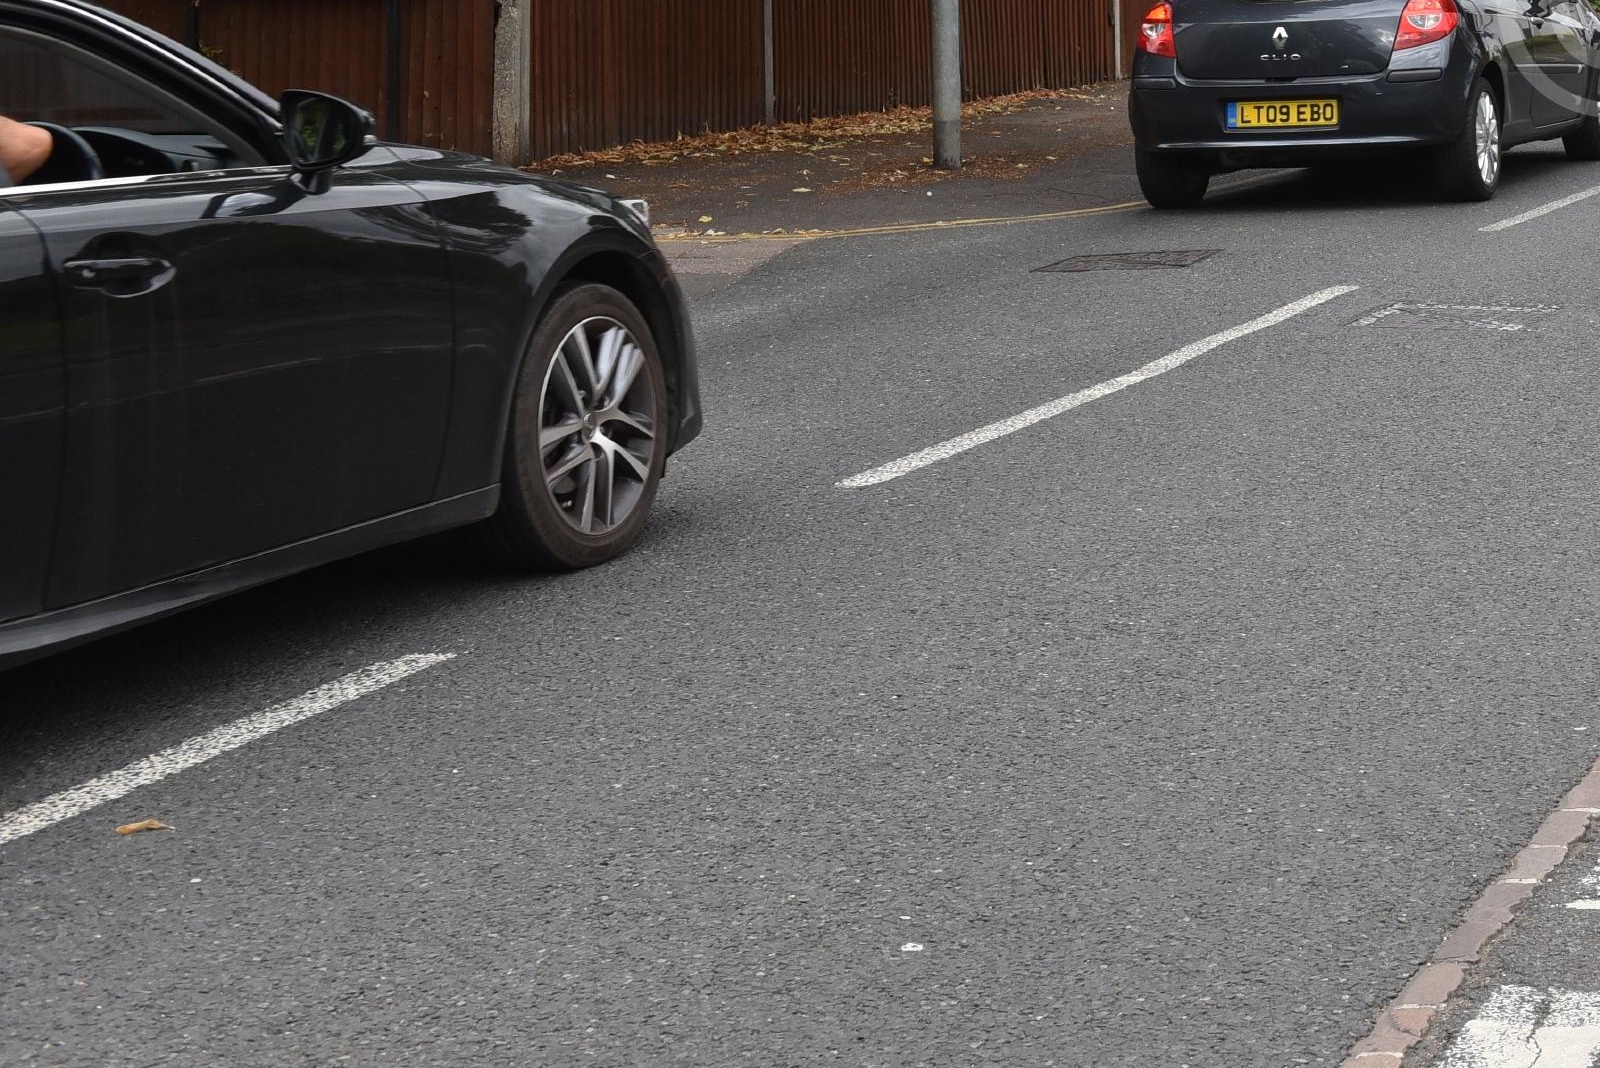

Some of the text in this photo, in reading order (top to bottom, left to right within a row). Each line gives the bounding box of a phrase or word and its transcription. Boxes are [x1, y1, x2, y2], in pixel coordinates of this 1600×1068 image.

[1260, 53, 1301, 61] CLIO
[1240, 103, 1334, 124] LT09 EBO
